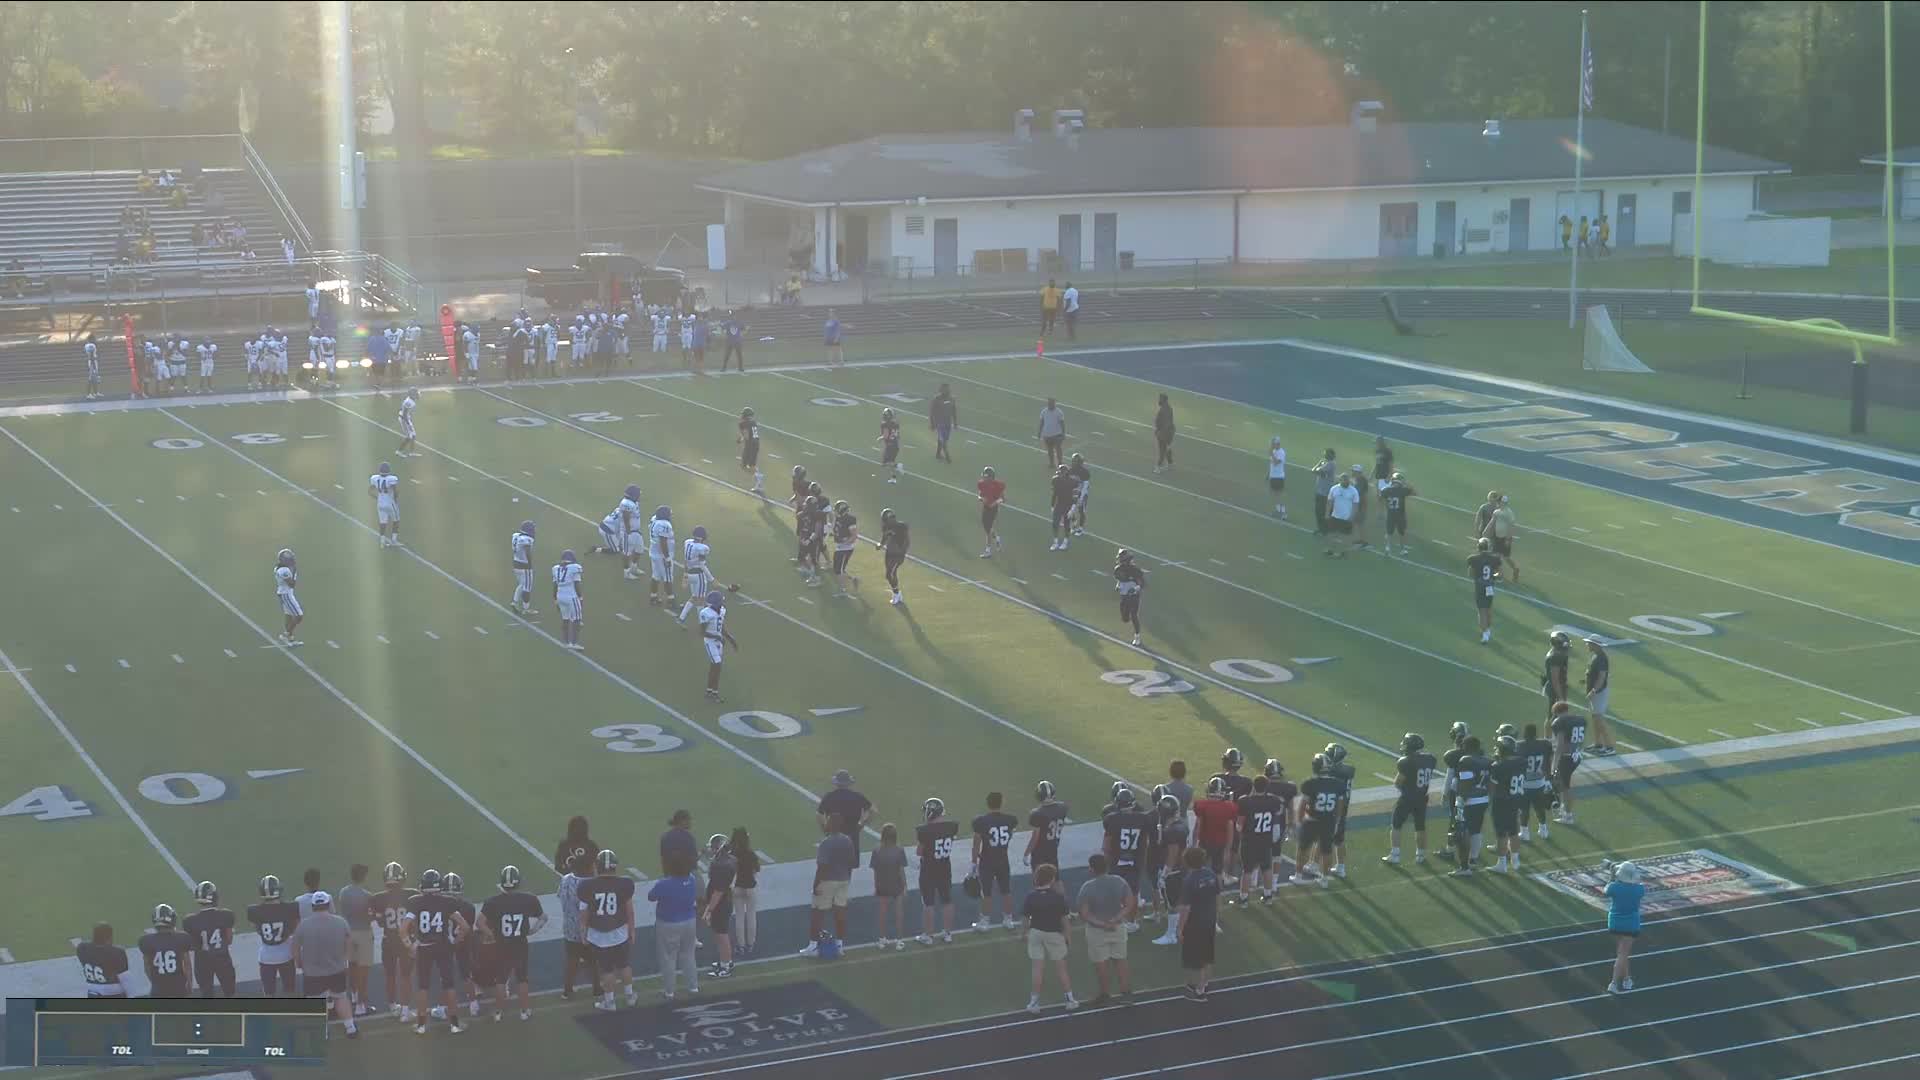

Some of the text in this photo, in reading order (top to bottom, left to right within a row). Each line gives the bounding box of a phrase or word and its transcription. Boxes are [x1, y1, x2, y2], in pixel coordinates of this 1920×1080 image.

[1482, 565, 1491, 580] 9
[1315, 792, 1336, 812] 25
[1253, 811, 1272, 833] 72
[988, 825, 1011, 848] 35
[1119, 828, 1141, 850] 57
[594, 892, 617, 915] 78
[261, 921, 284, 943] 87
[419, 911, 443, 933] 84
[501, 913, 524, 938] 67
[199, 927, 223, 951] 14
[152, 949, 177, 975] 46
[622, 1007, 849, 1051] EVOLVE
[656, 1041, 729, 1061] bank
[772, 1022, 846, 1041] trust
